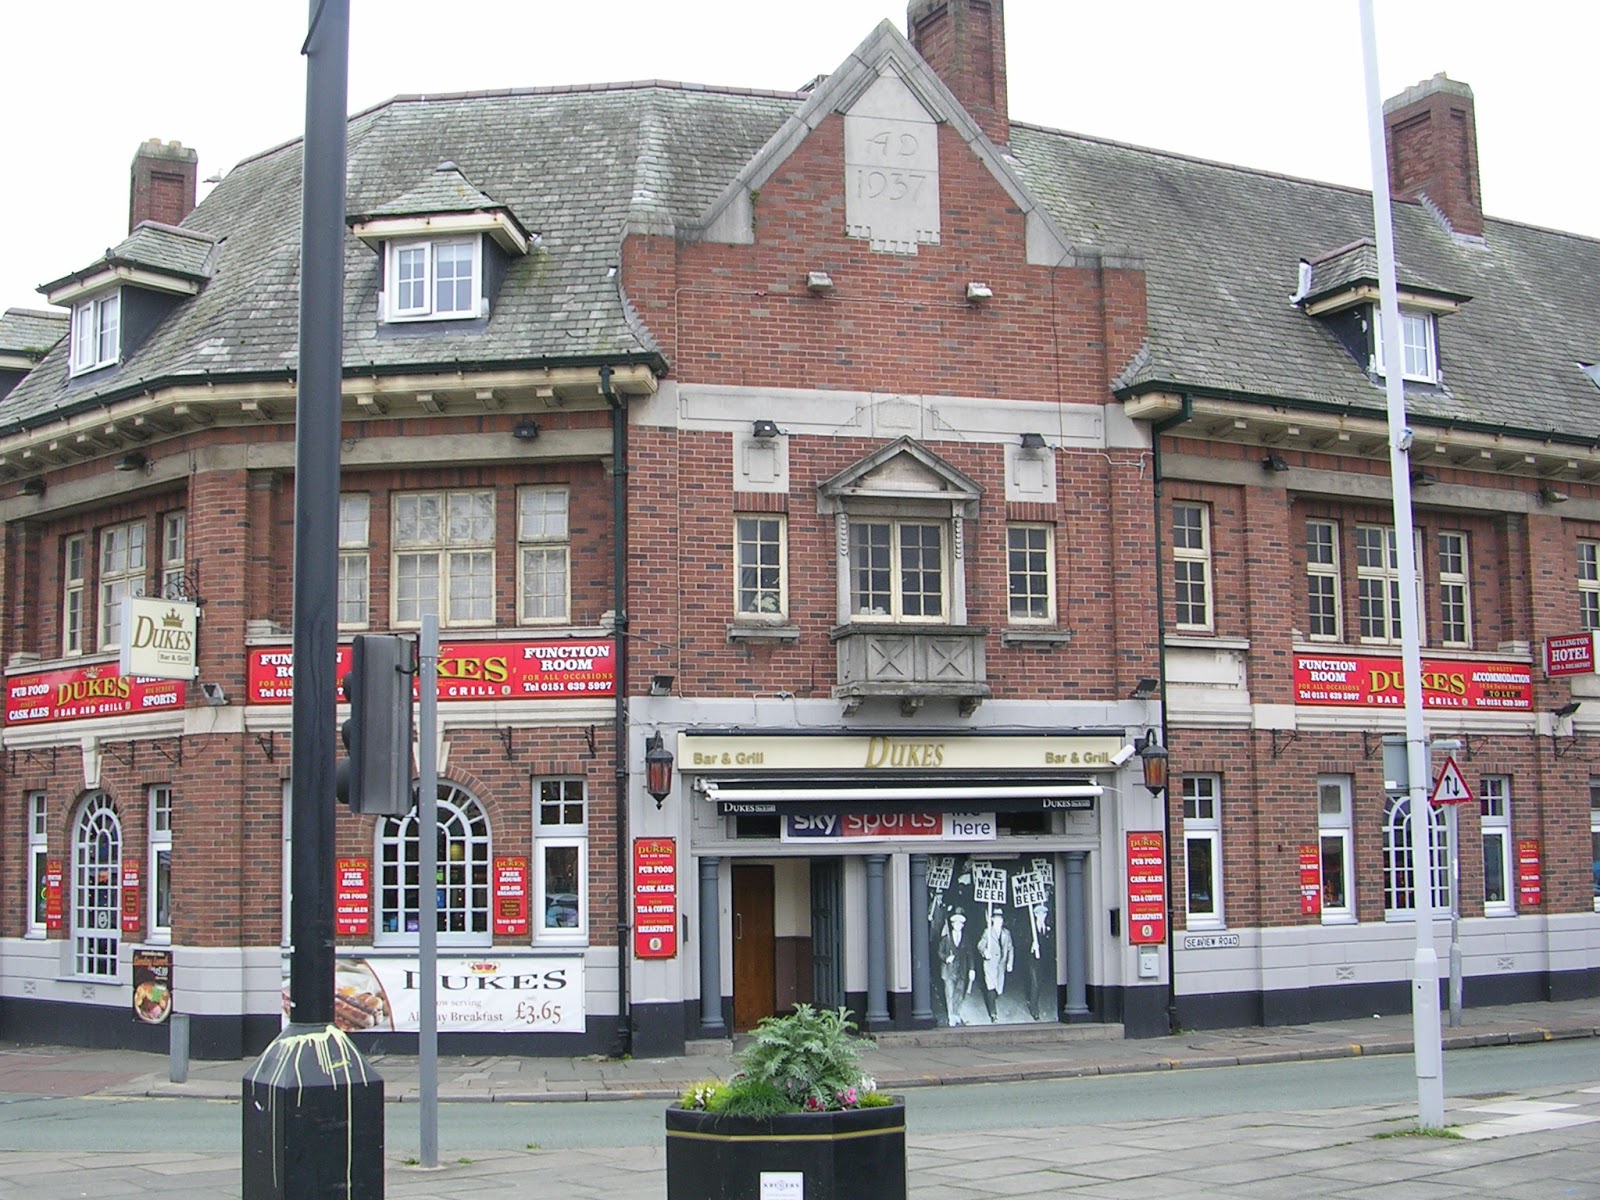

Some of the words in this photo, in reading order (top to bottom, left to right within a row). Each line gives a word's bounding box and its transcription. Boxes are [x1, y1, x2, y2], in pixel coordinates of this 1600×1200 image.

[858, 169, 926, 203] 1937
[131, 615, 193, 651] DUKES
[524, 645, 610, 659] FUNCTION
[1552, 647, 1589, 662] HOTEL
[541, 659, 593, 671] ROOM
[1298, 660, 1356, 671] FUNCTION
[563, 672, 613, 680] OCCASIONS
[1311, 671, 1346, 682] ROOM
[11, 686, 27, 697] PUB
[28, 684, 50, 696] FOOD
[57, 676, 130, 707] DUKES
[449, 685, 495, 696] GRILL
[523, 682, 539, 692] Tel
[541, 682, 564, 691] 0151
[567, 682, 586, 691] 639
[588, 681, 612, 690] 5997
[259, 689, 274, 697] Tel
[1300, 691, 1311, 699] Tel
[143, 693, 177, 706] SPORTS
[1429, 696, 1458, 705] GRILL
[9, 708, 29, 720] CASK
[30, 707, 50, 718] ALES
[61, 707, 77, 716] BAR
[80, 705, 96, 714] AND
[99, 701, 123, 712] GRILL
[864, 736, 944, 768] DUKES
[1045, 752, 1067, 764] Bar
[1070, 752, 1080, 763] &
[1083, 751, 1110, 763] Grill
[693, 752, 717, 765] Bar
[721, 752, 731, 765] &
[735, 752, 764, 765] Grill
[724, 802, 755, 812] DUKES
[1042, 798, 1071, 808] DUKES
[952, 820, 991, 835] here
[638, 846, 673, 854] DUKES
[932, 873, 950, 882] WANT
[981, 869, 1003, 879] WE
[1016, 873, 1038, 884] WE
[978, 878, 1004, 890] WANT
[1014, 881, 1042, 895] WANT
[976, 889, 1005, 901] BEER
[1016, 892, 1044, 906] BEER
[1186, 937, 1216, 948] SEAVIEW
[1219, 936, 1237, 946] ROAD
[451, 999, 482, 1007] serving
[451, 1011, 504, 1022] Breakfast
[515, 1000, 562, 1025] £3.65
